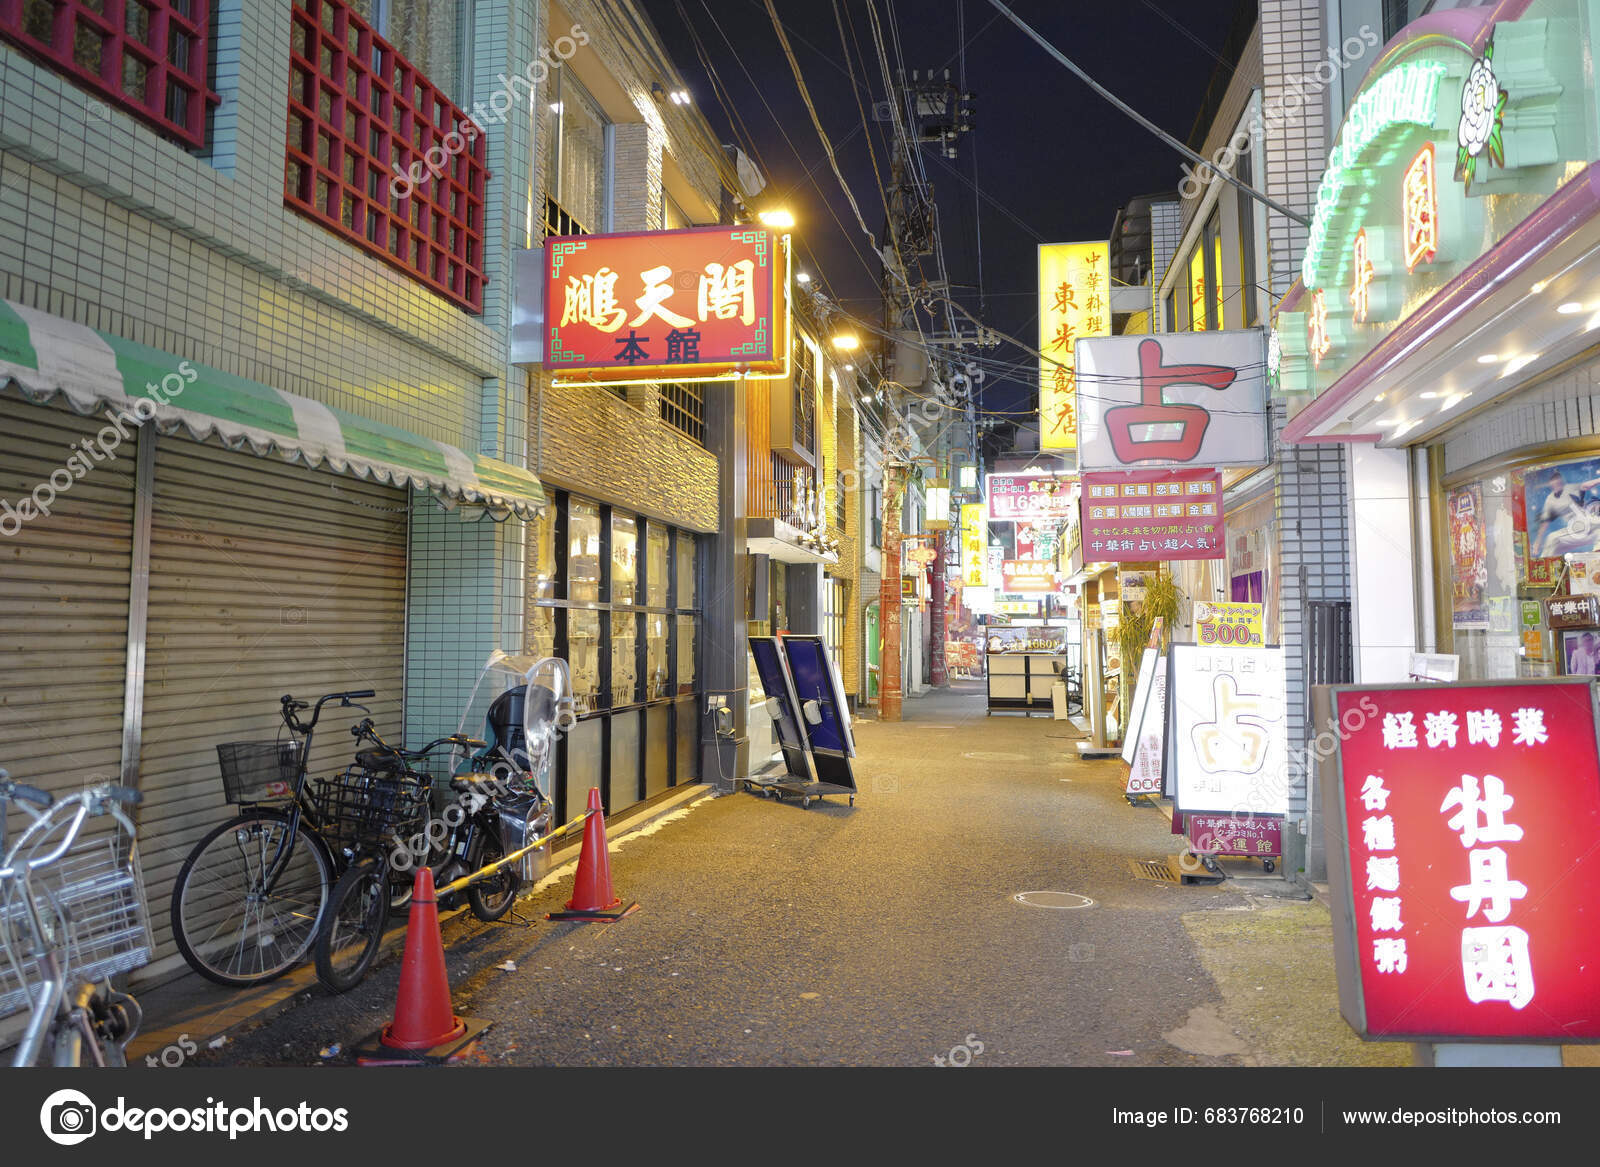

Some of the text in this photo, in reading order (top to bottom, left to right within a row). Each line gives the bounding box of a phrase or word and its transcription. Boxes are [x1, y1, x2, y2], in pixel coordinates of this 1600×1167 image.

[560, 258, 756, 334] 鵬天閣
[1084, 250, 1105, 333] 中華料理
[614, 328, 701, 366] 本館
[1104, 338, 1239, 464] 占
[1155, 483, 1181, 496] 恋愛
[1188, 482, 1213, 495] 結婚
[1156, 504, 1182, 517] 仕事
[1550, 600, 1591, 616] 営業中
[1209, 837, 1273, 853] 金運館
[1439, 773, 1536, 1011] 牡丹園
